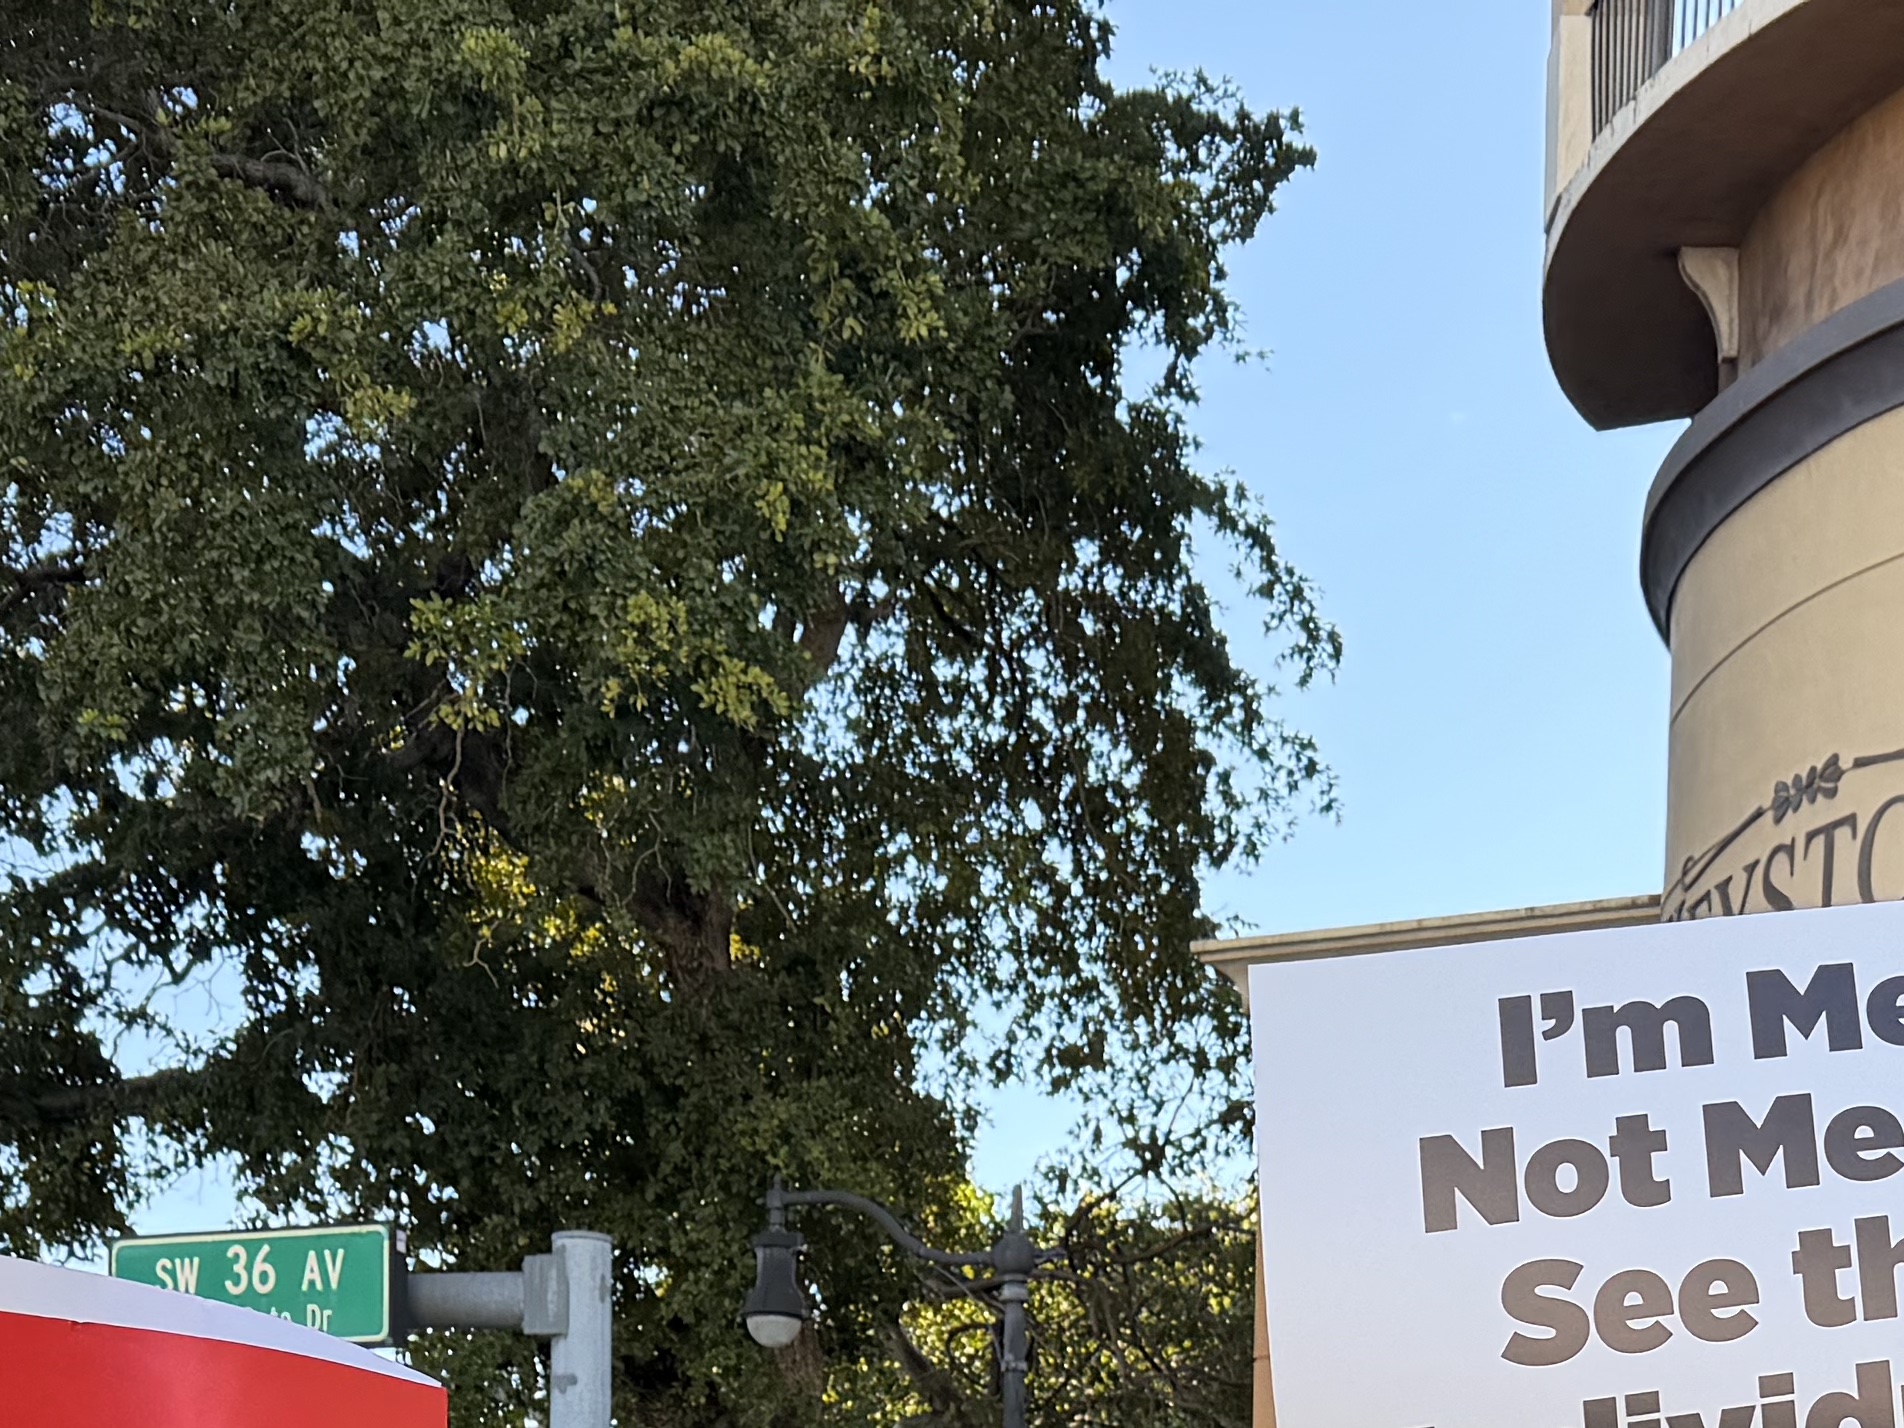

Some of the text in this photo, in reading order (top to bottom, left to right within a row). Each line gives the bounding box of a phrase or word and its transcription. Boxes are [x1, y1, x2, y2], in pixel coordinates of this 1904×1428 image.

[1498, 991, 1714, 1087] I'm
[1420, 1114, 1671, 1233] Not
[155, 1244, 345, 1295] SW 36 AV
[306, 1303, 333, 1332] Dr
[1501, 1259, 1759, 1366] See
